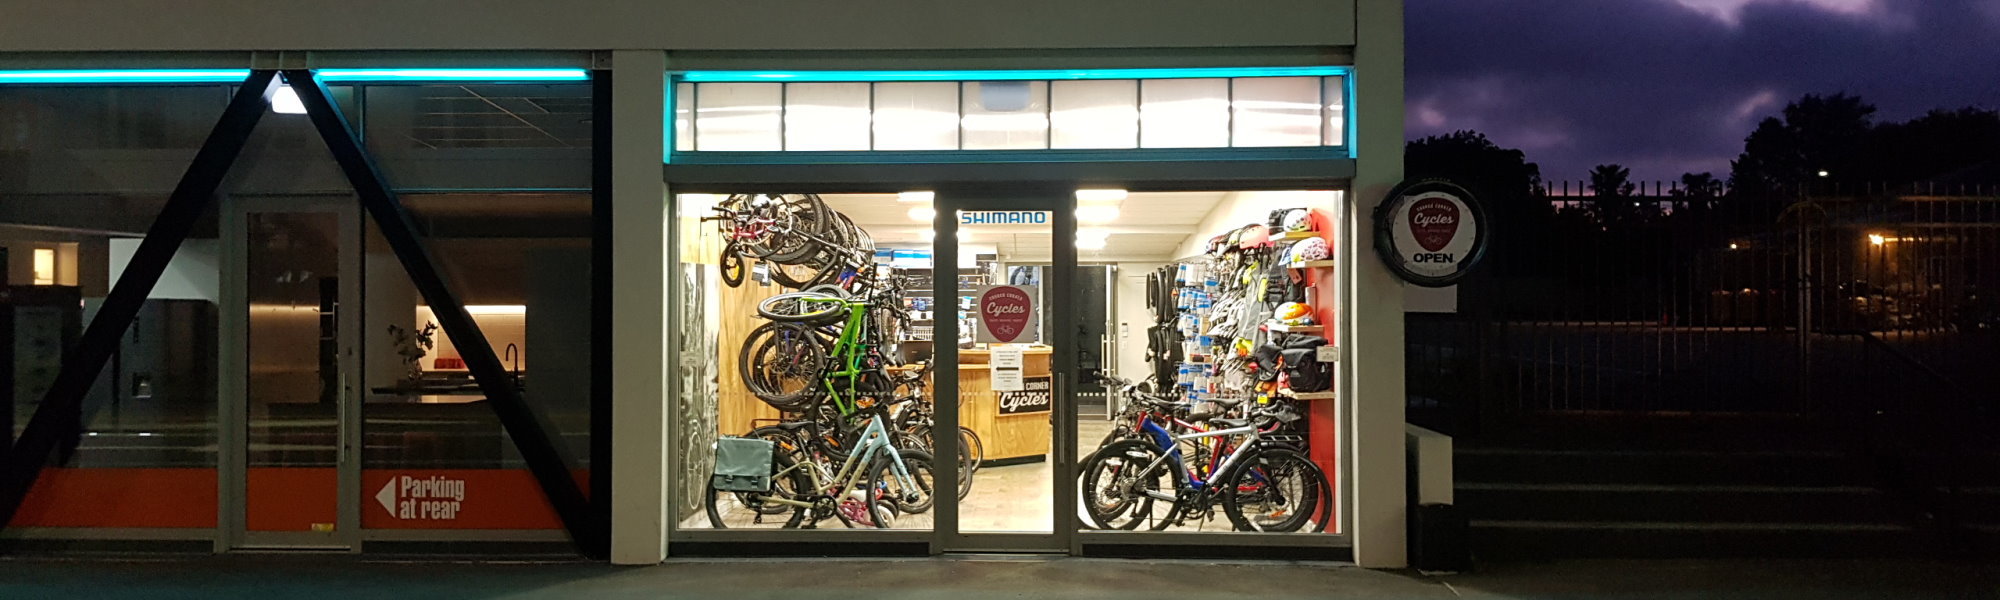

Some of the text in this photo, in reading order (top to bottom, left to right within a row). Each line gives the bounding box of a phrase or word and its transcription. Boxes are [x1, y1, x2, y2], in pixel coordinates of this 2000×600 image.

[961, 212, 1046, 224] SHIMANO
[1414, 212, 1455, 228] Cycles
[1413, 253, 1453, 263] OPEN
[987, 302, 1025, 317] Cycles
[1025, 381, 1049, 390] CORNER
[1000, 391, 1049, 412] Cycles
[401, 475, 465, 502] Parking
[400, 498, 460, 520] at rear
